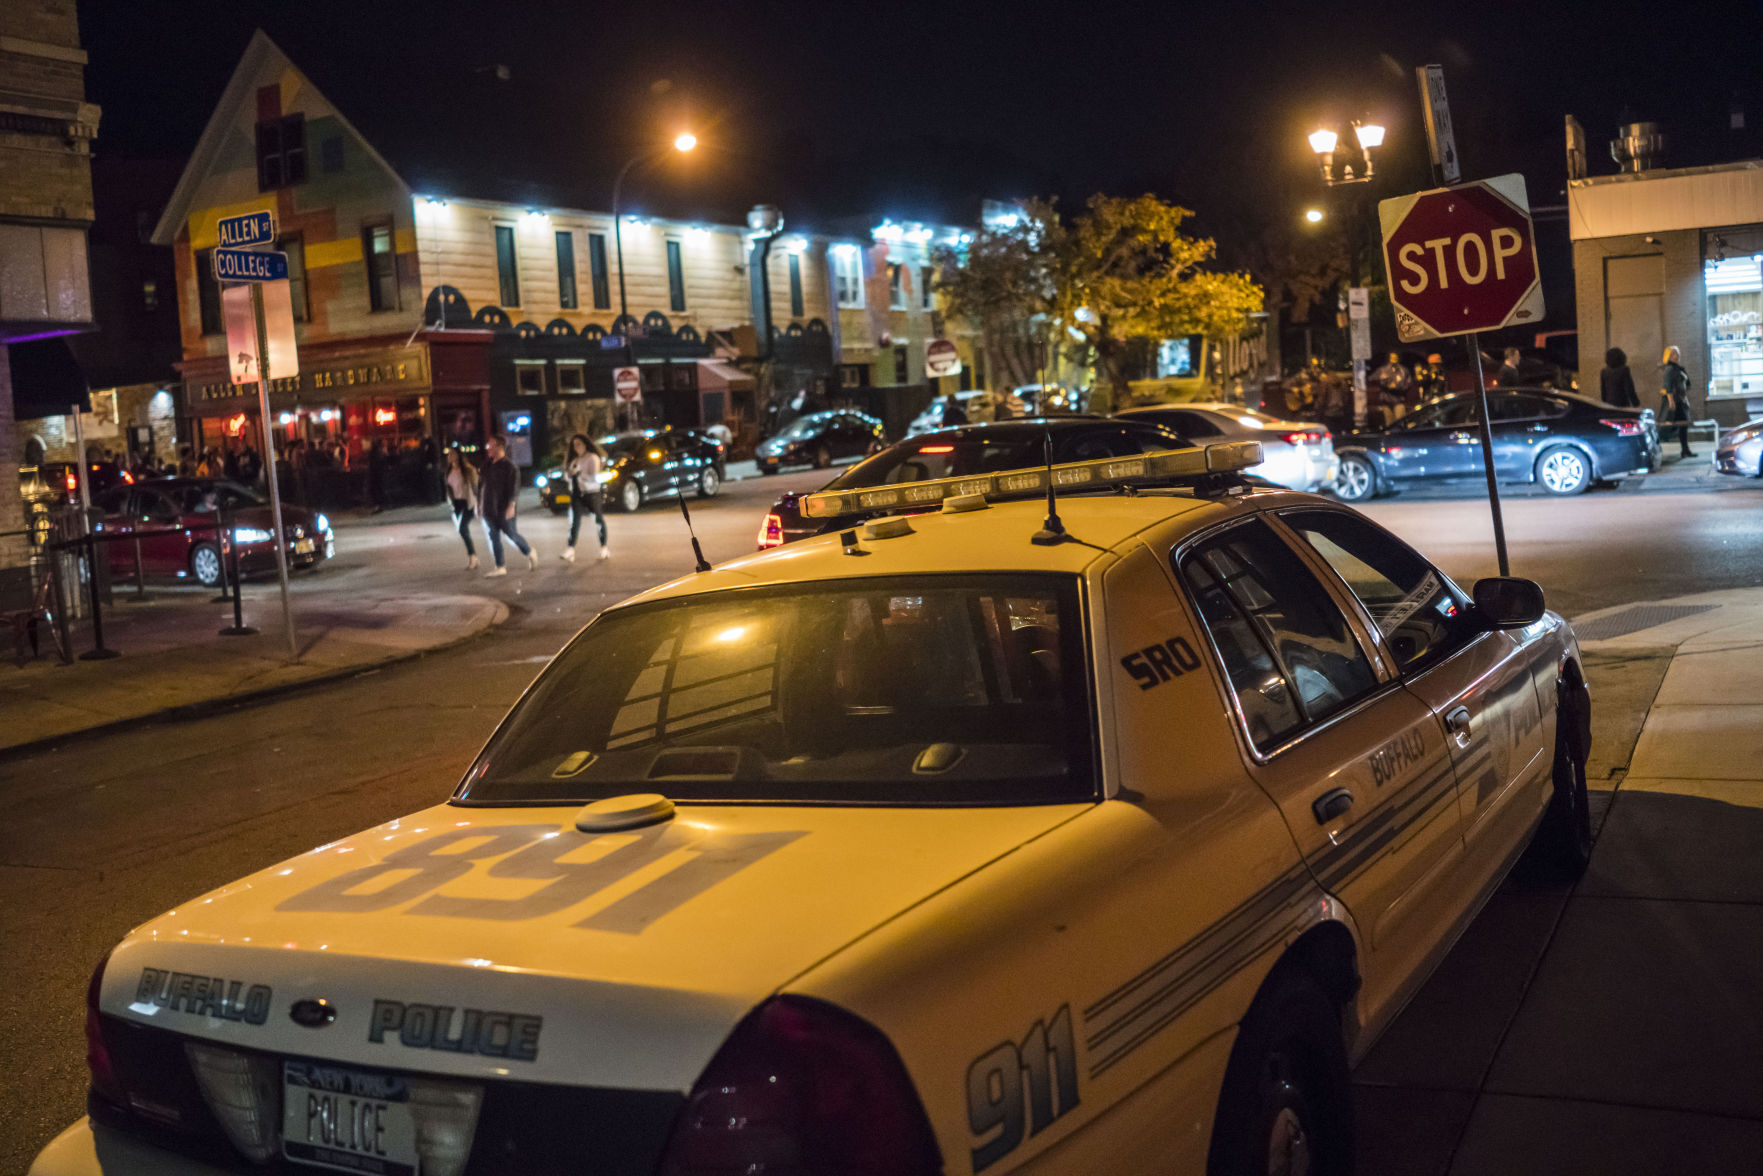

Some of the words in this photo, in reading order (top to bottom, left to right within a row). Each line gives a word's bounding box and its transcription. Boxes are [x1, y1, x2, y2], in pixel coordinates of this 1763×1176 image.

[220, 218, 259, 245] ALLEN
[1399, 227, 1523, 295] STOP
[217, 253, 272, 277] COLLEGE
[1120, 635, 1202, 691] SRO
[1369, 726, 1426, 787] BUFFALO
[274, 823, 812, 935] 891
[135, 967, 273, 1026] BUFFALO
[367, 998, 544, 1063] POLICE
[966, 1003, 1081, 1175] 911
[307, 1091, 388, 1157] POLICE
